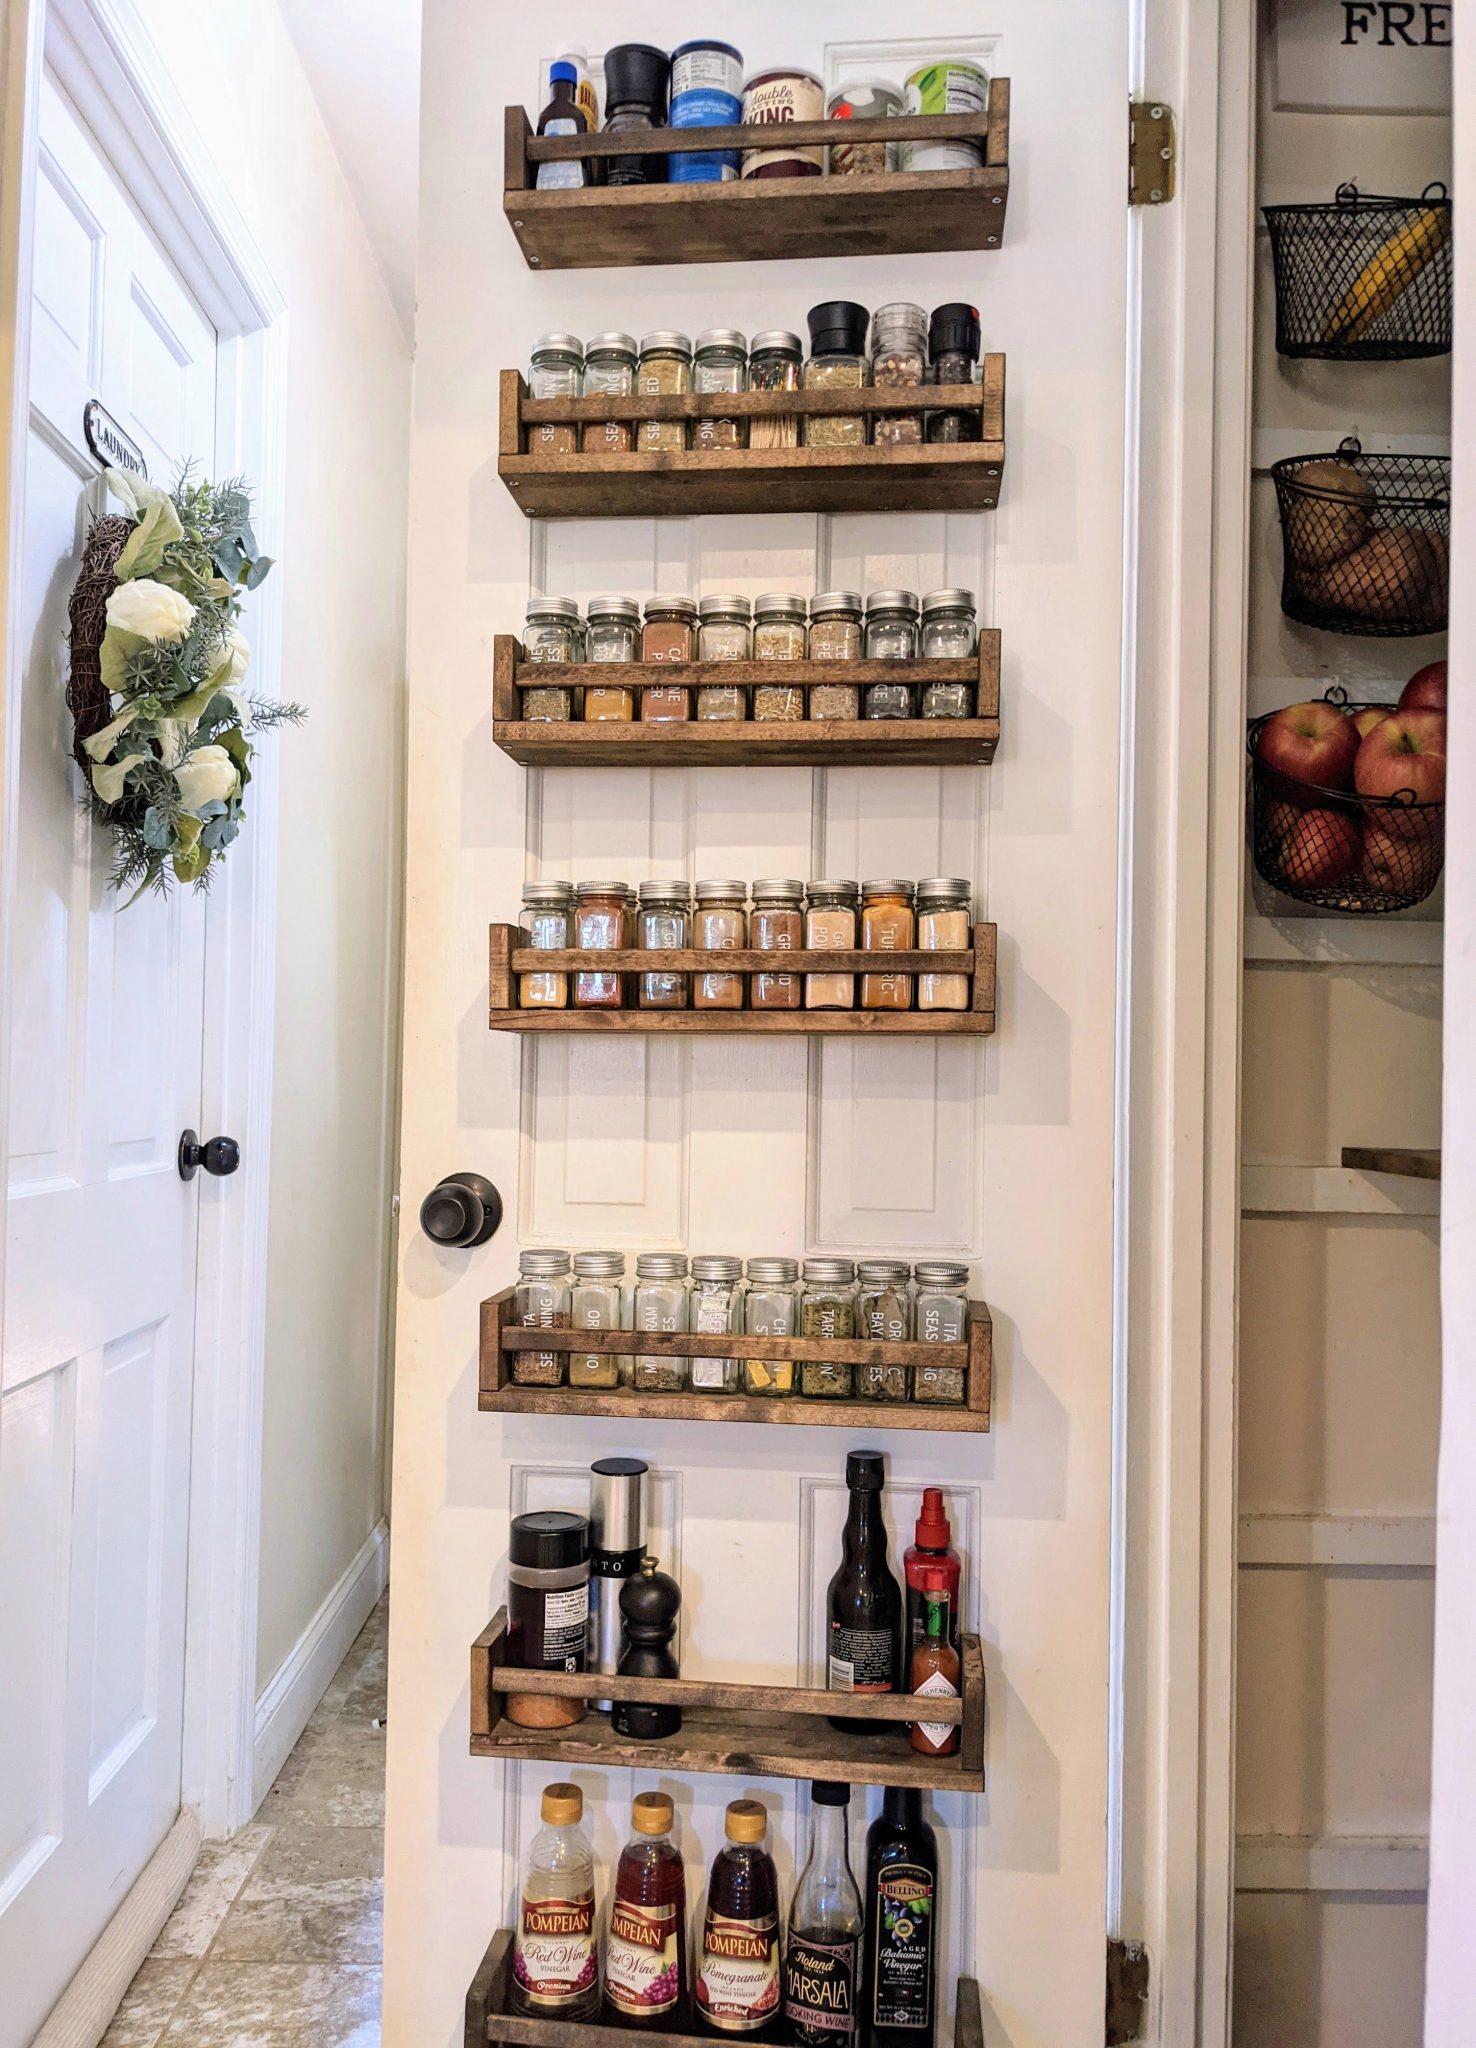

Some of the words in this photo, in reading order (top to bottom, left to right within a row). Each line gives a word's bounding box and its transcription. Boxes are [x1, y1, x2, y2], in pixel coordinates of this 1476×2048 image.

[751, 84, 794, 106] double
[750, 99, 794, 113] ACTING
[605, 375, 620, 442] SEAING
[94, 418, 141, 474] LAUNDRY
[540, 1298, 553, 1368] SENING
[870, 1312, 884, 1335] BAY
[923, 1309, 939, 1381] SEASNG
[887, 1885, 925, 1896] BELLINO
[526, 1911, 589, 1932] POMPEIAN
[524, 1942, 553, 1963] Red
[553, 1939, 586, 1965] Wine
[705, 1931, 768, 1957] POMPEIAN
[880, 1948, 925, 1960] Balsamic
[902, 1945, 926, 1953] AGED
[540, 1965, 570, 1973] VINEGAR
[621, 1953, 656, 1975] Wine
[702, 1956, 769, 1985] Pomegranate
[795, 1951, 834, 1972] Roland
[883, 1958, 922, 1972] Vinegar
[536, 1981, 571, 1990] Premium
[787, 1964, 848, 2009] MARSALA
[714, 2003, 749, 2017] Enriched
[825, 2015, 852, 2029] WINE
